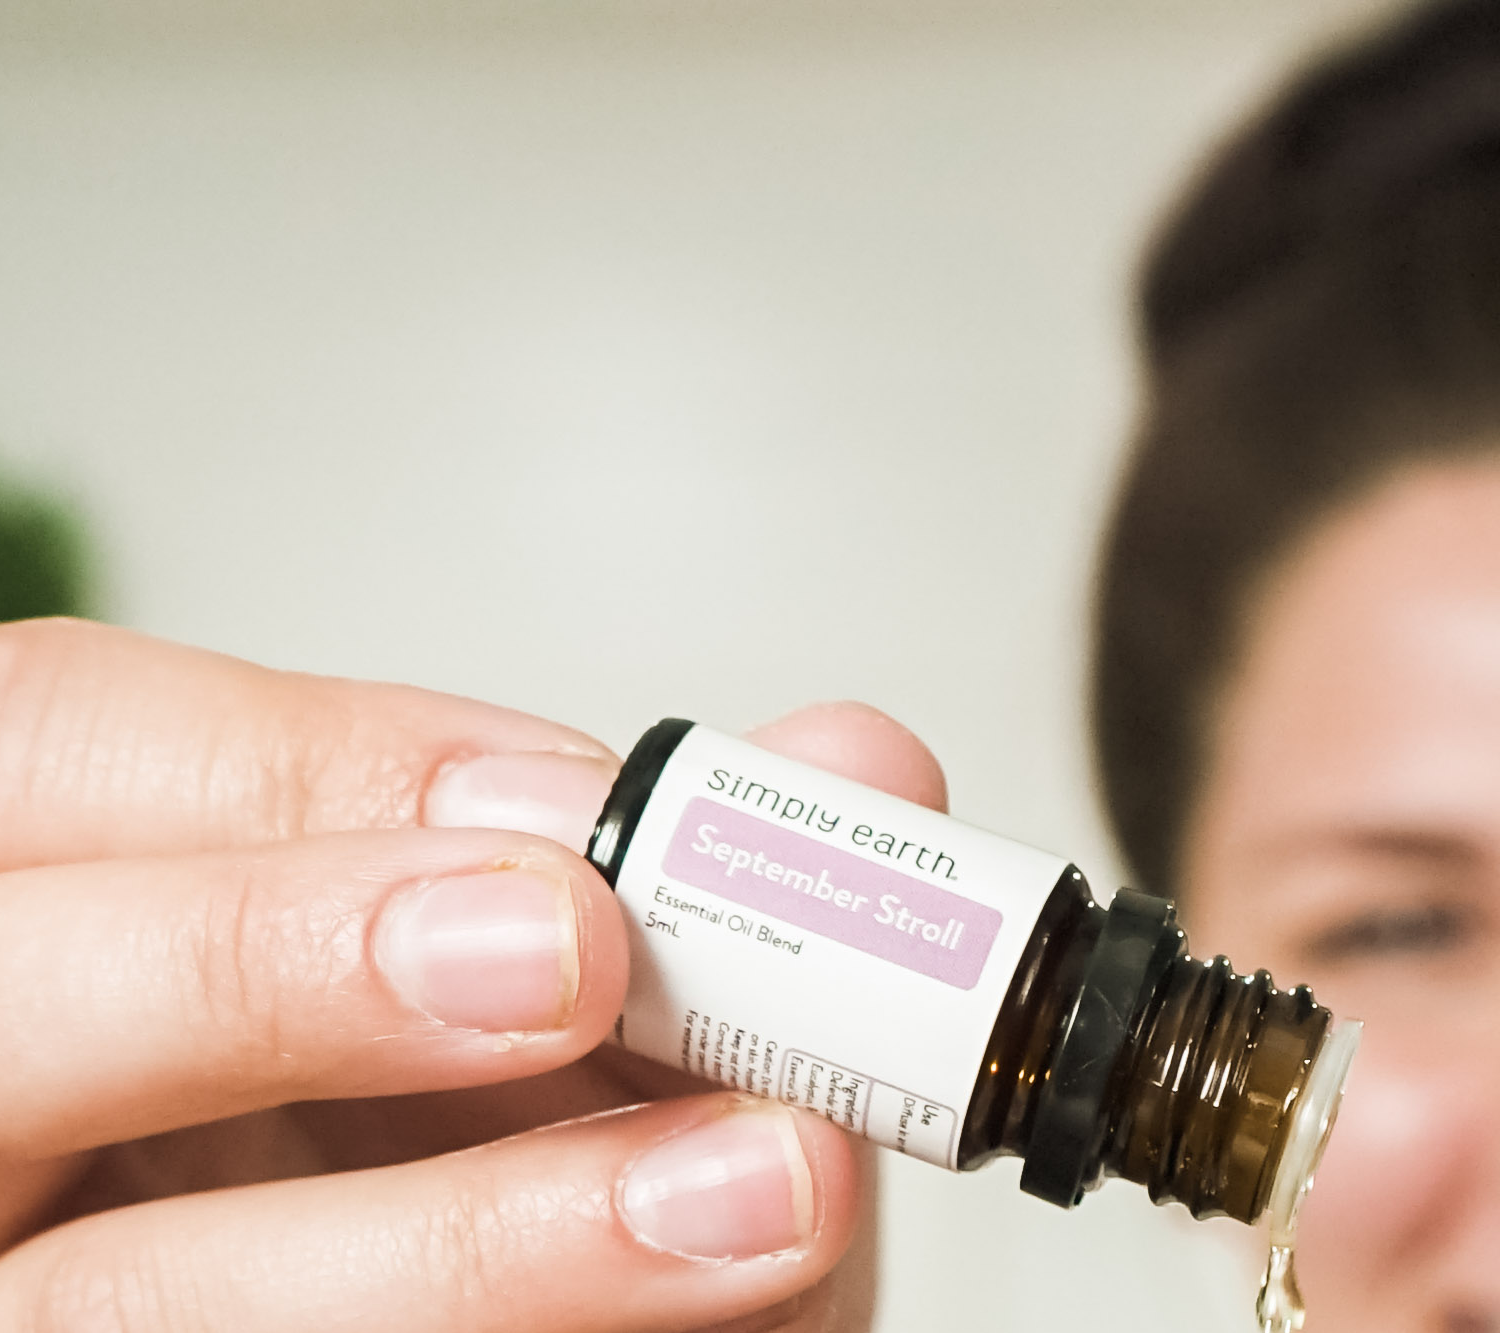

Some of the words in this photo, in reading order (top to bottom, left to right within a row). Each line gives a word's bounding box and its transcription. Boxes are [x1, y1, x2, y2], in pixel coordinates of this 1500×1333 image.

[707, 768, 841, 833] simply
[690, 823, 869, 913] September
[872, 894, 965, 950] Stroll
[644, 911, 681, 939] 5mL
[653, 885, 725, 925] Essential
[727, 914, 755, 937] Oil
[756, 924, 804, 955] Blend
[920, 1104, 940, 1126] Use
